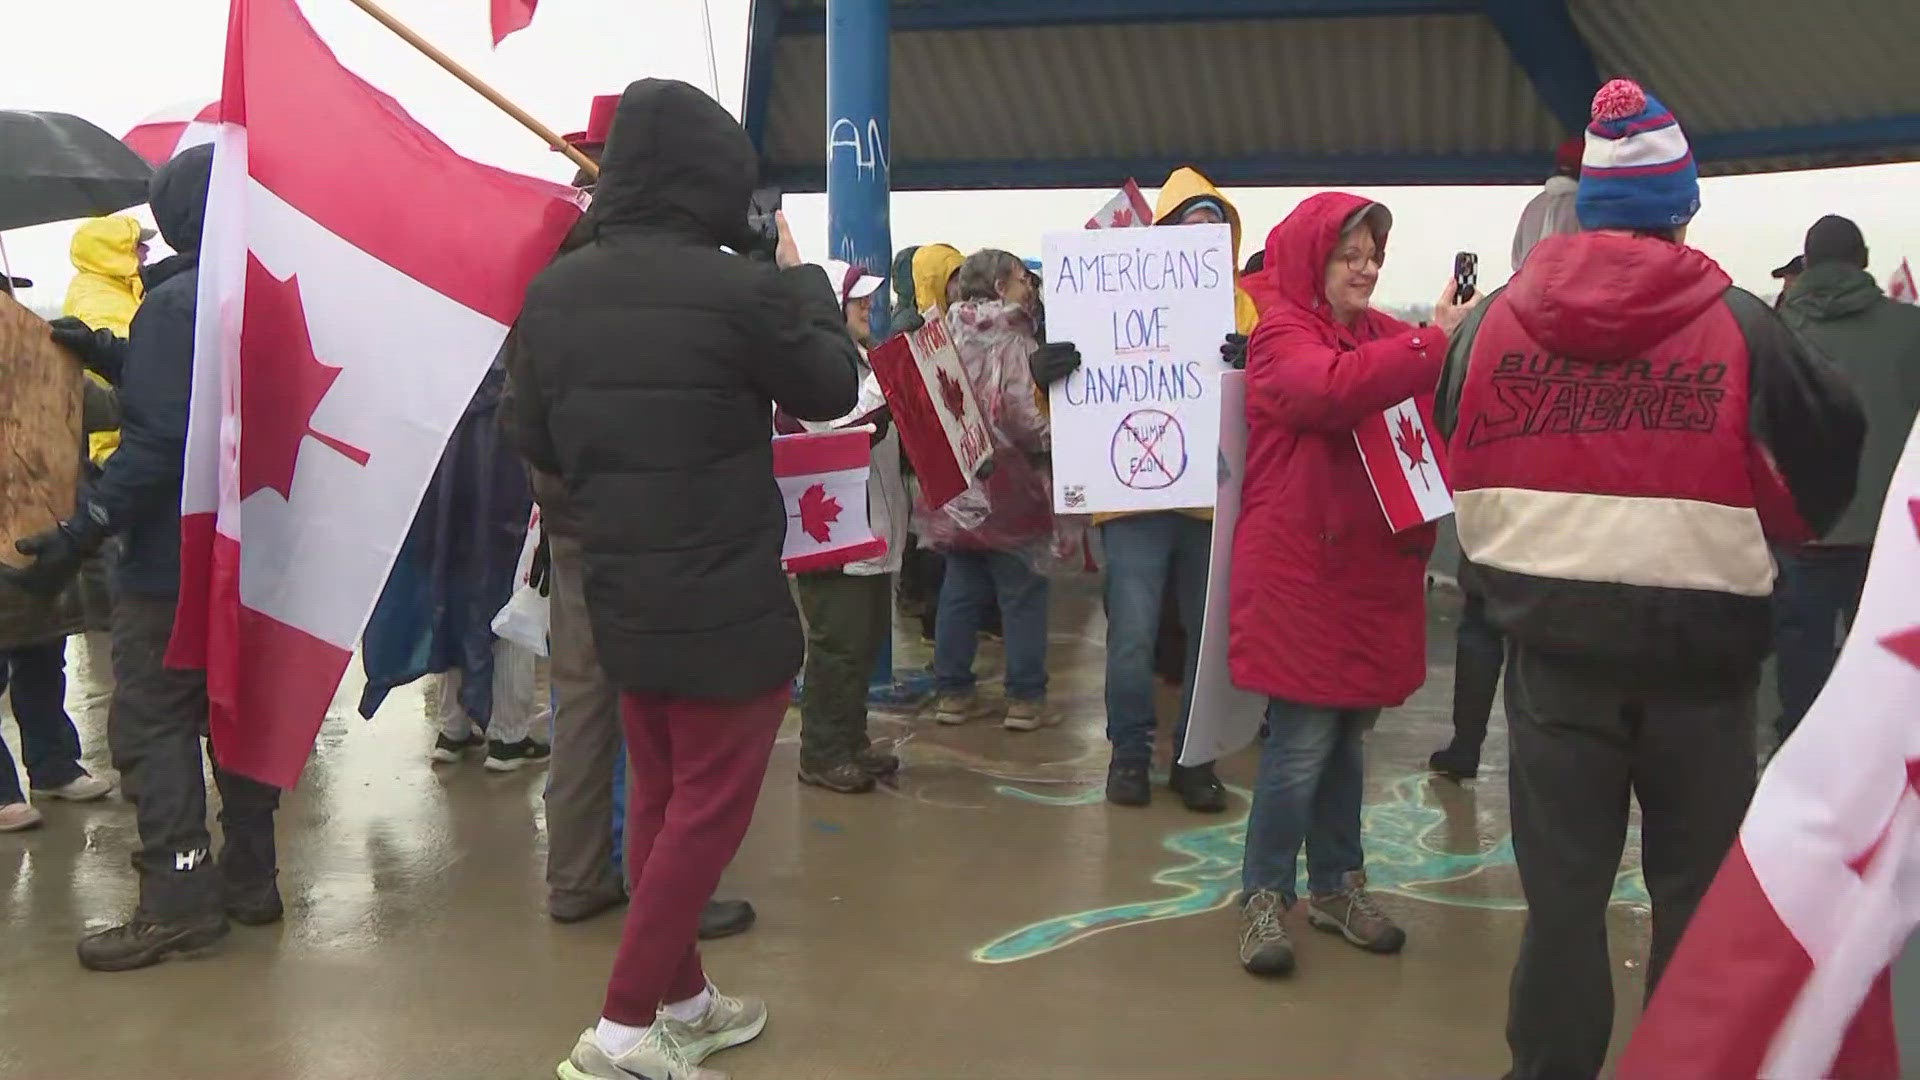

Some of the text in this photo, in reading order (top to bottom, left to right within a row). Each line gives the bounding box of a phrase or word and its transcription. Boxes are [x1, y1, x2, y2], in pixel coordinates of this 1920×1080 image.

[1113, 306, 1171, 351] LOVE
[1492, 352, 1727, 384] BUFFALO
[1466, 375, 1726, 449] SABRES
[1123, 424, 1167, 443] TRUMP
[1129, 453, 1166, 475] ELON
